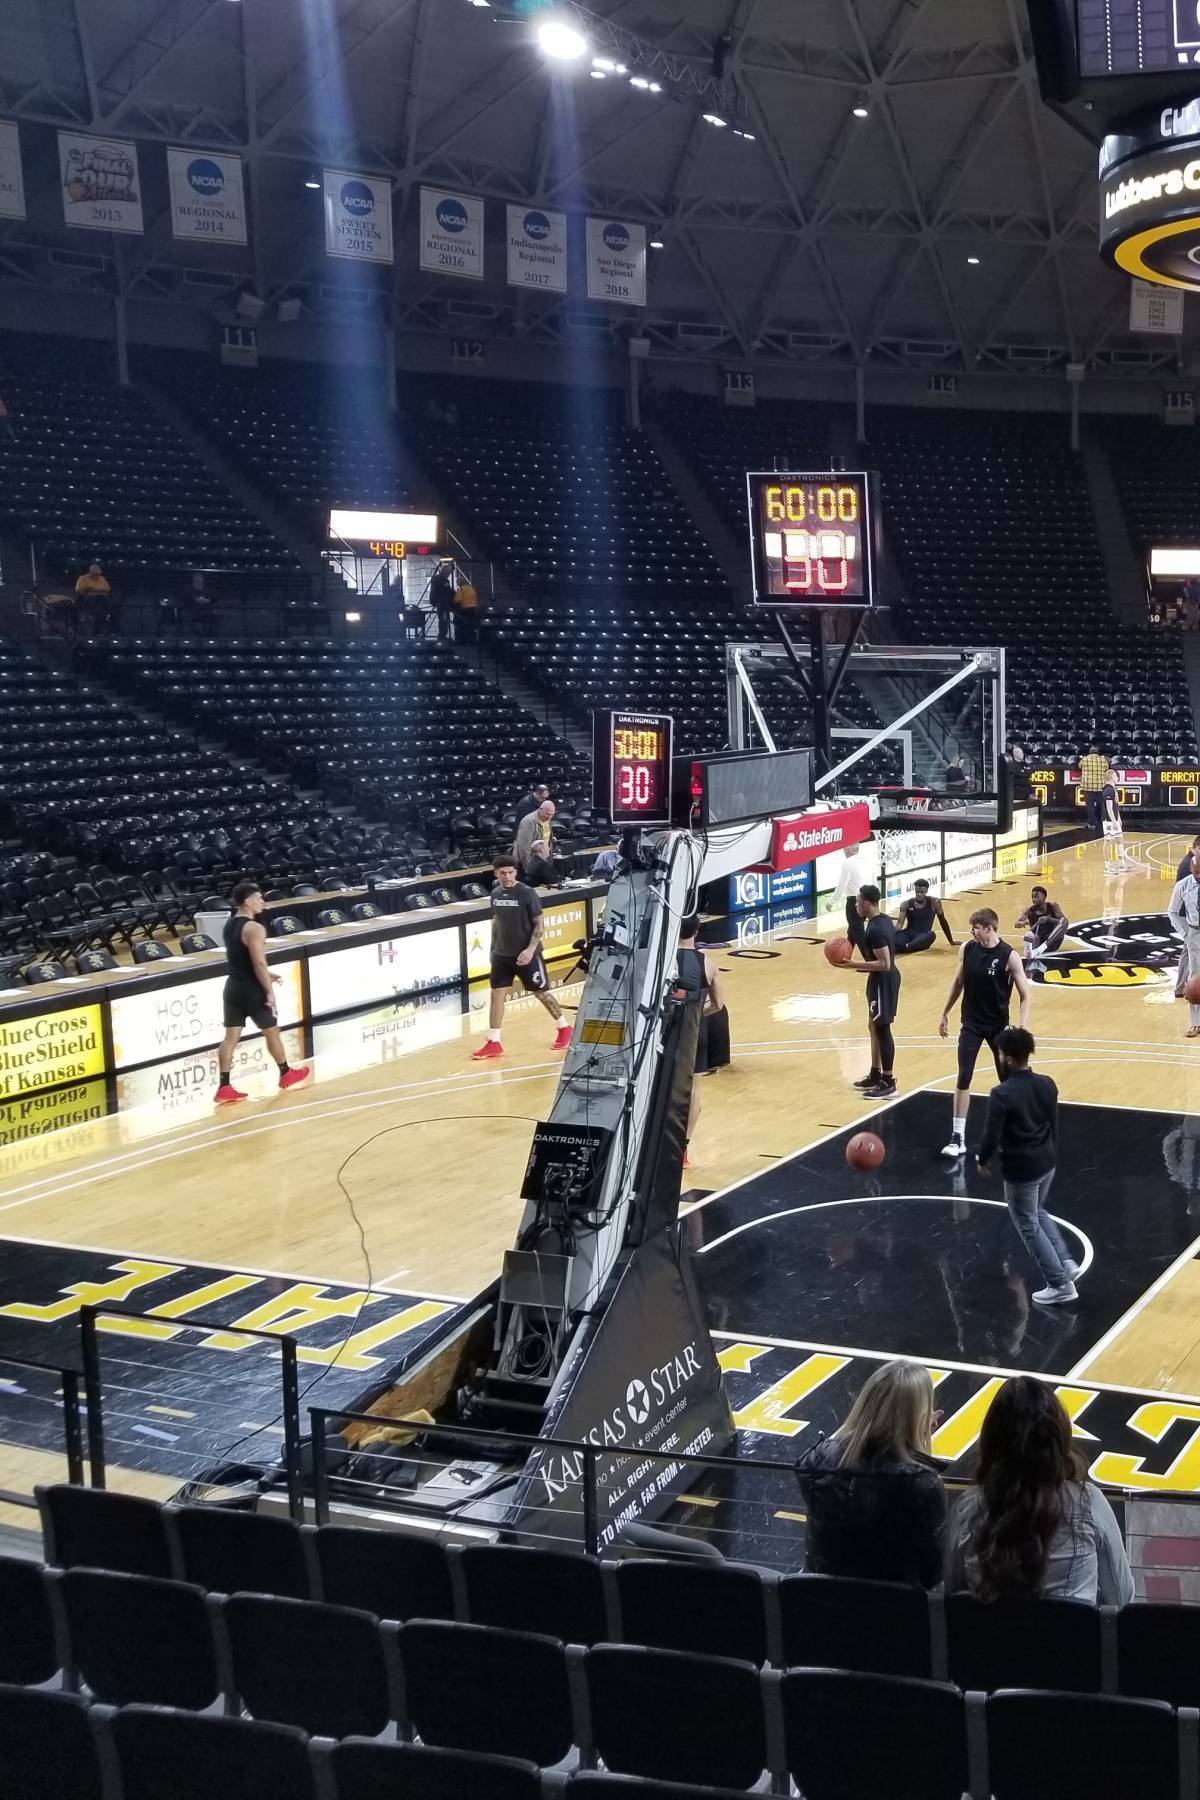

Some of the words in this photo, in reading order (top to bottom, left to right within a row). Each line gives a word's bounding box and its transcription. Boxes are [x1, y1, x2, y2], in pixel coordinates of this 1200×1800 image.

[191, 174, 224, 188] NCAA
[344, 196, 374, 209] NCAA
[91, 206, 122, 222] 2013
[179, 205, 239, 221] REGIONAL
[438, 213, 467, 226] NCAA
[194, 218, 225, 233] 2014
[341, 218, 376, 231] SWEET
[345, 238, 374, 252] 2015
[426, 240, 478, 257] REGIONAL
[511, 237, 562, 255] Indianapolis
[438, 253, 465, 268] 2016
[518, 251, 556, 265] Regional
[524, 272, 550, 285] 2017
[605, 283, 629, 297] 2018
[767, 487, 857, 522] 60:00
[369, 542, 405, 558] 4:48
[618, 715, 659, 725] DAKTRONICS
[621, 766, 649, 804] 30
[1186, 787, 1196, 804] 0
[734, 872, 765, 905] ICI
[157, 994, 199, 1020] HOG
[155, 1019, 203, 1045] WILD
[18, 1060, 86, 1090] Kansas
[534, 1133, 600, 1147] DAKTRONICS
[650, 1345, 702, 1407] STAR
[644, 1418, 665, 1443] event
[665, 1397, 688, 1424] center
[602, 1525, 614, 1546] TO
[656, 1461, 678, 1492] FROM
